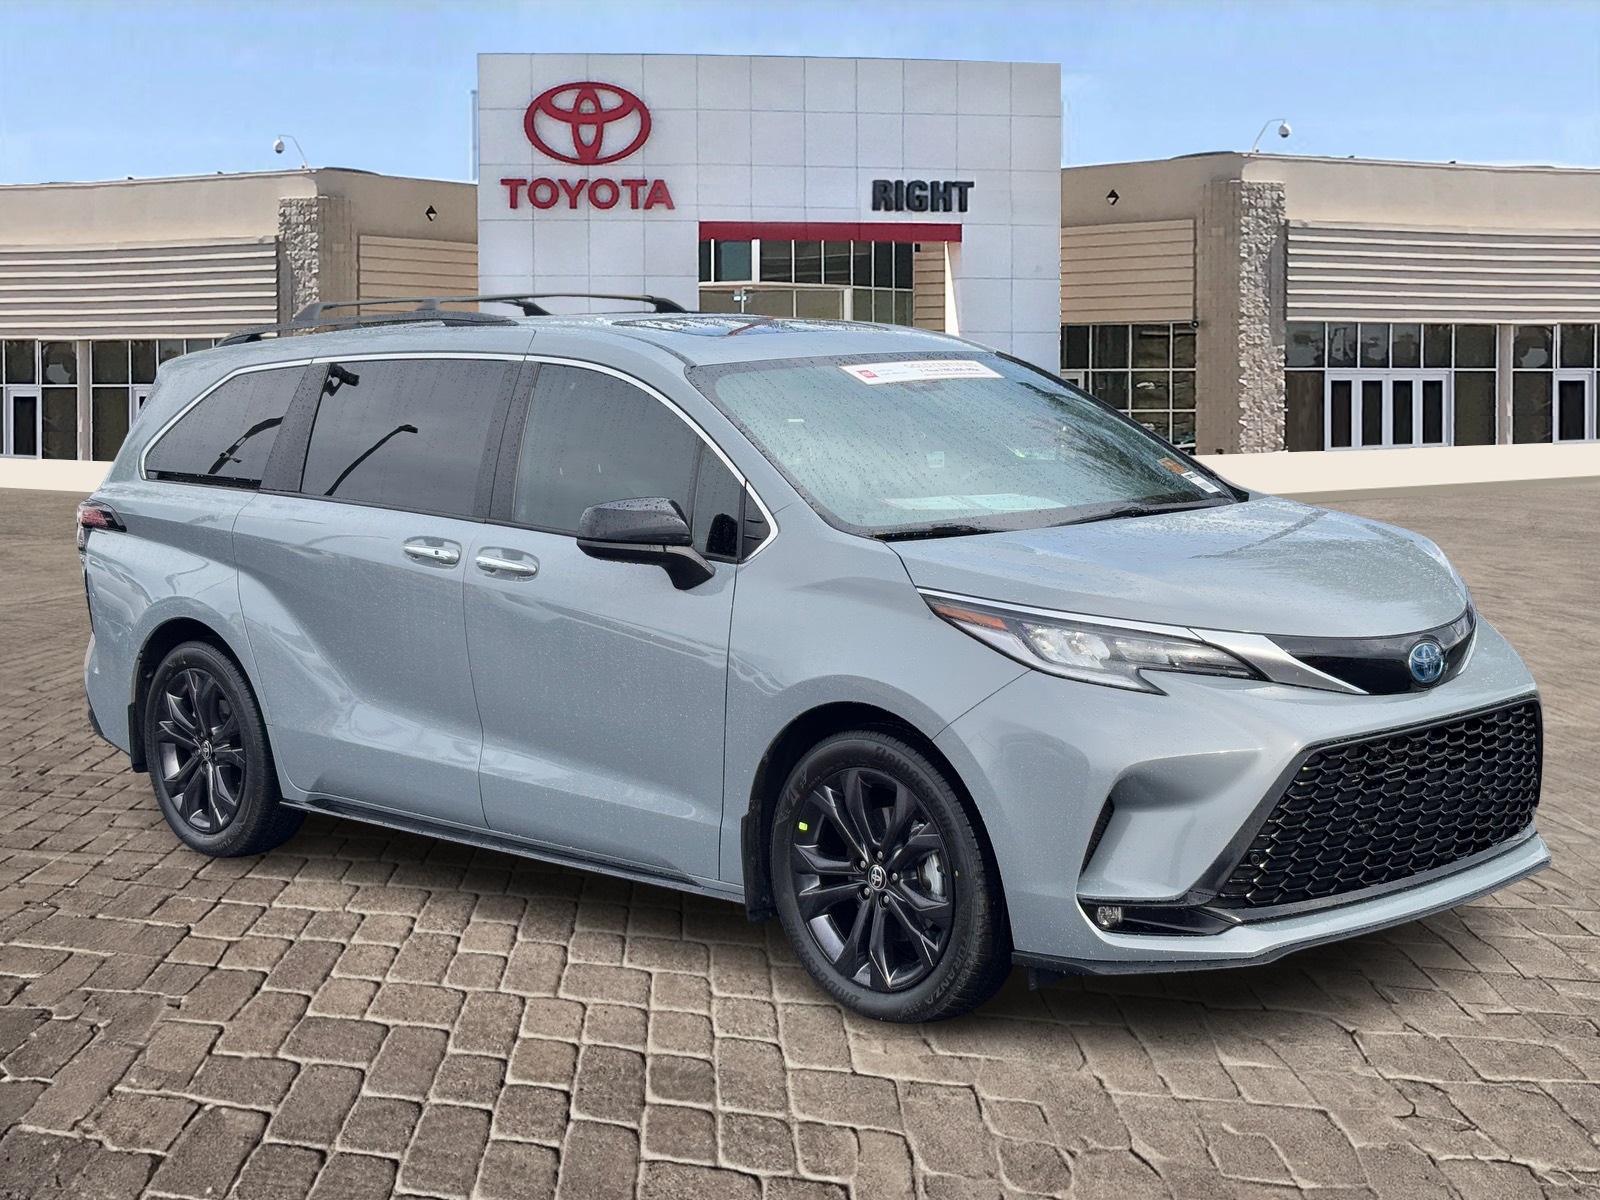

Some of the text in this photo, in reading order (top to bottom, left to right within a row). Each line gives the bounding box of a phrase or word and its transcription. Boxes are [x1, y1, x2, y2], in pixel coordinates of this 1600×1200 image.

[501, 178, 675, 210] TOYOTA
[872, 180, 975, 212] RIGHT
[875, 745, 958, 839] BRIDGESTONE
[924, 935, 970, 1005] TURANZA
